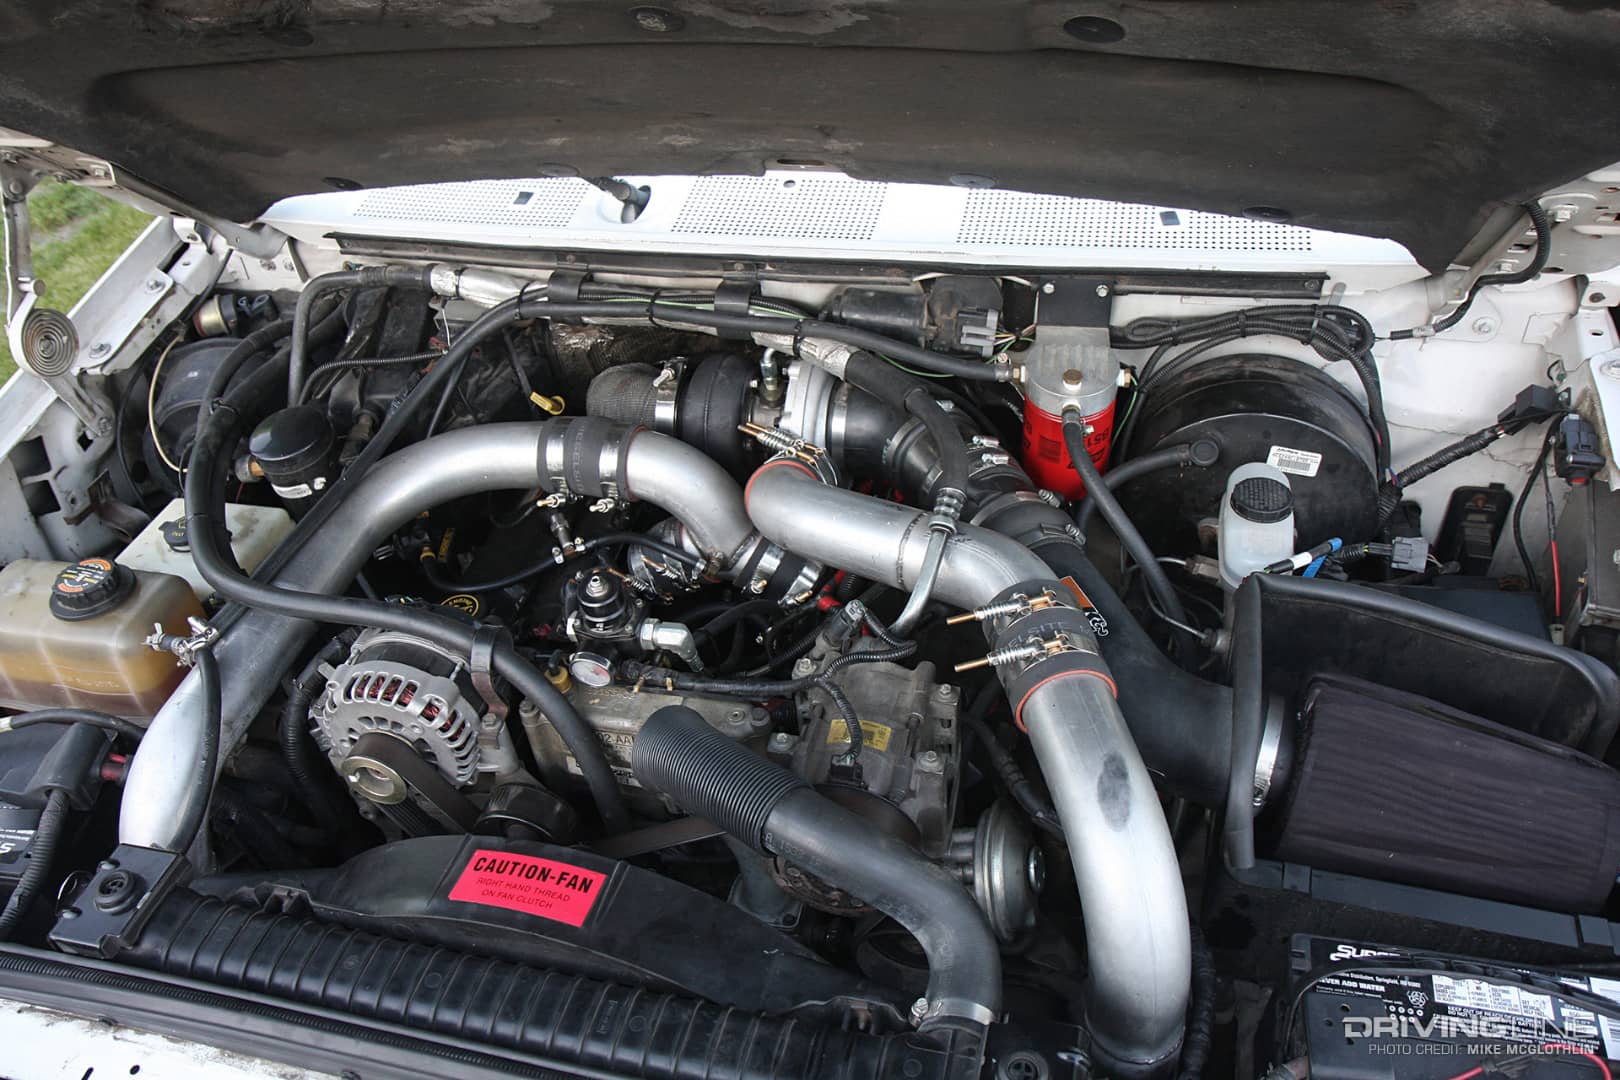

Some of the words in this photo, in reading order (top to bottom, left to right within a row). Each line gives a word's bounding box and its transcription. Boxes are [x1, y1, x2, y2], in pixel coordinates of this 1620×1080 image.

[473, 857, 594, 894] CAUTION-FAN
[477, 877, 504, 889] RIGHT
[505, 882, 531, 895] HAND
[534, 886, 571, 902] THREAD
[481, 888, 497, 898] ON
[497, 891, 514, 902] FAN
[516, 894, 553, 910] CLUTCH
[1359, 982, 1386, 993] WATER
